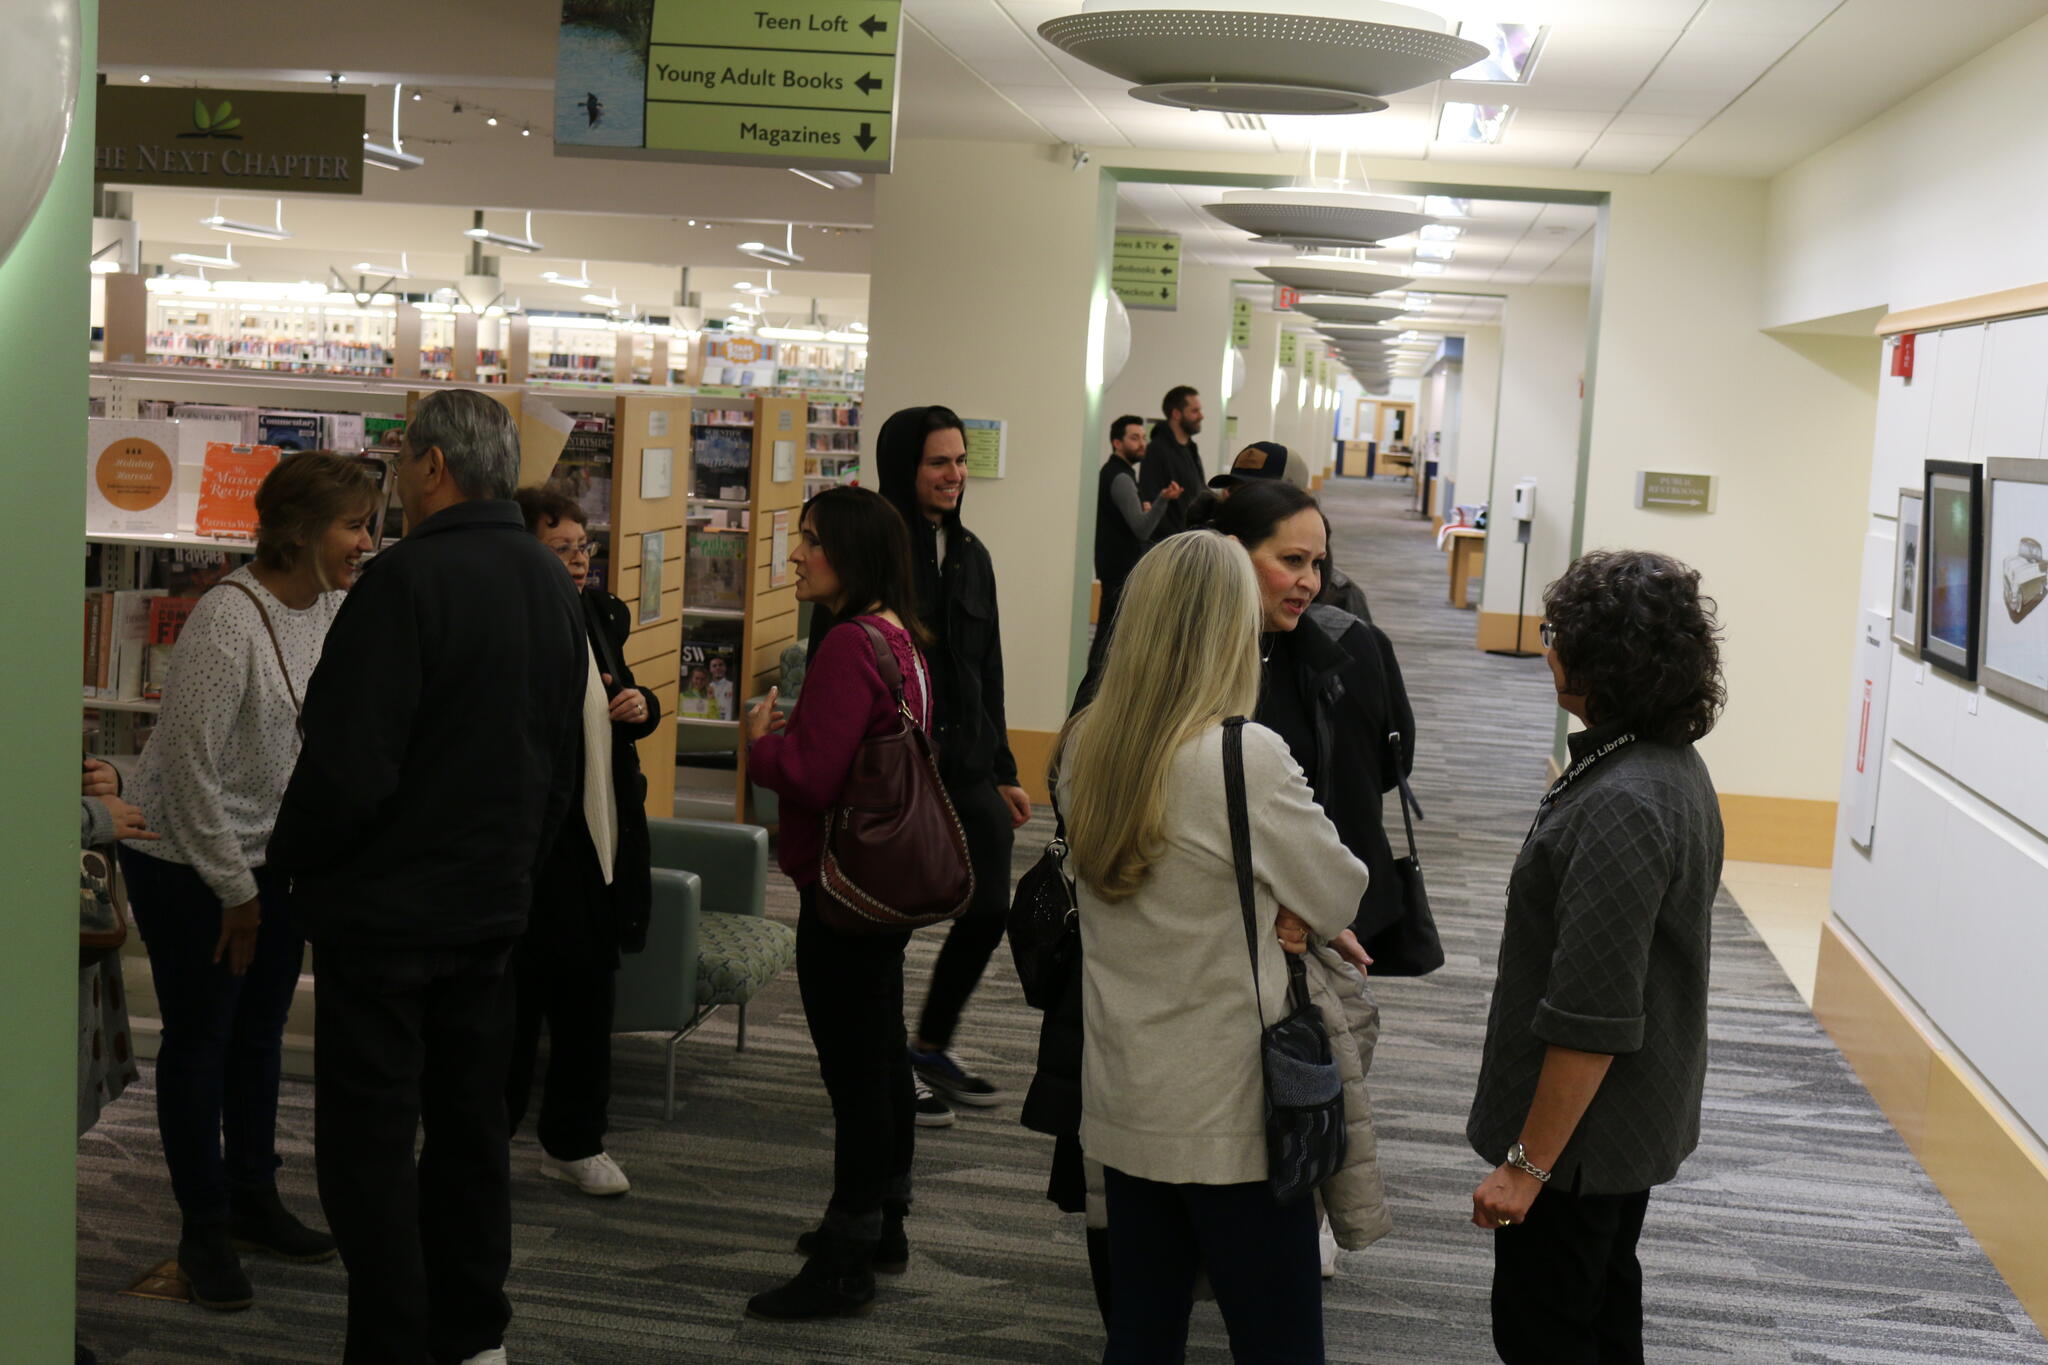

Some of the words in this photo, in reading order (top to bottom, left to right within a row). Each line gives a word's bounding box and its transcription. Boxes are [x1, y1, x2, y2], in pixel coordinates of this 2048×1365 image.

[754, 12, 801, 30] Teen
[808, 14, 849, 33] Loft
[656, 63, 716, 89] Young
[720, 67, 776, 87] Adult
[782, 70, 844, 90] Books
[740, 122, 841, 147] Magazines
[95, 146, 126, 171] HE
[137, 145, 214, 175] NEXT
[221, 149, 350, 181] CHAPTER
[260, 416, 317, 429] Commentary
[114, 458, 154, 470] Holiday
[215, 471, 263, 486] Master
[210, 483, 259, 500] Recipe
[1568, 754, 1596, 780] Public
[1596, 733, 1636, 757] Library
